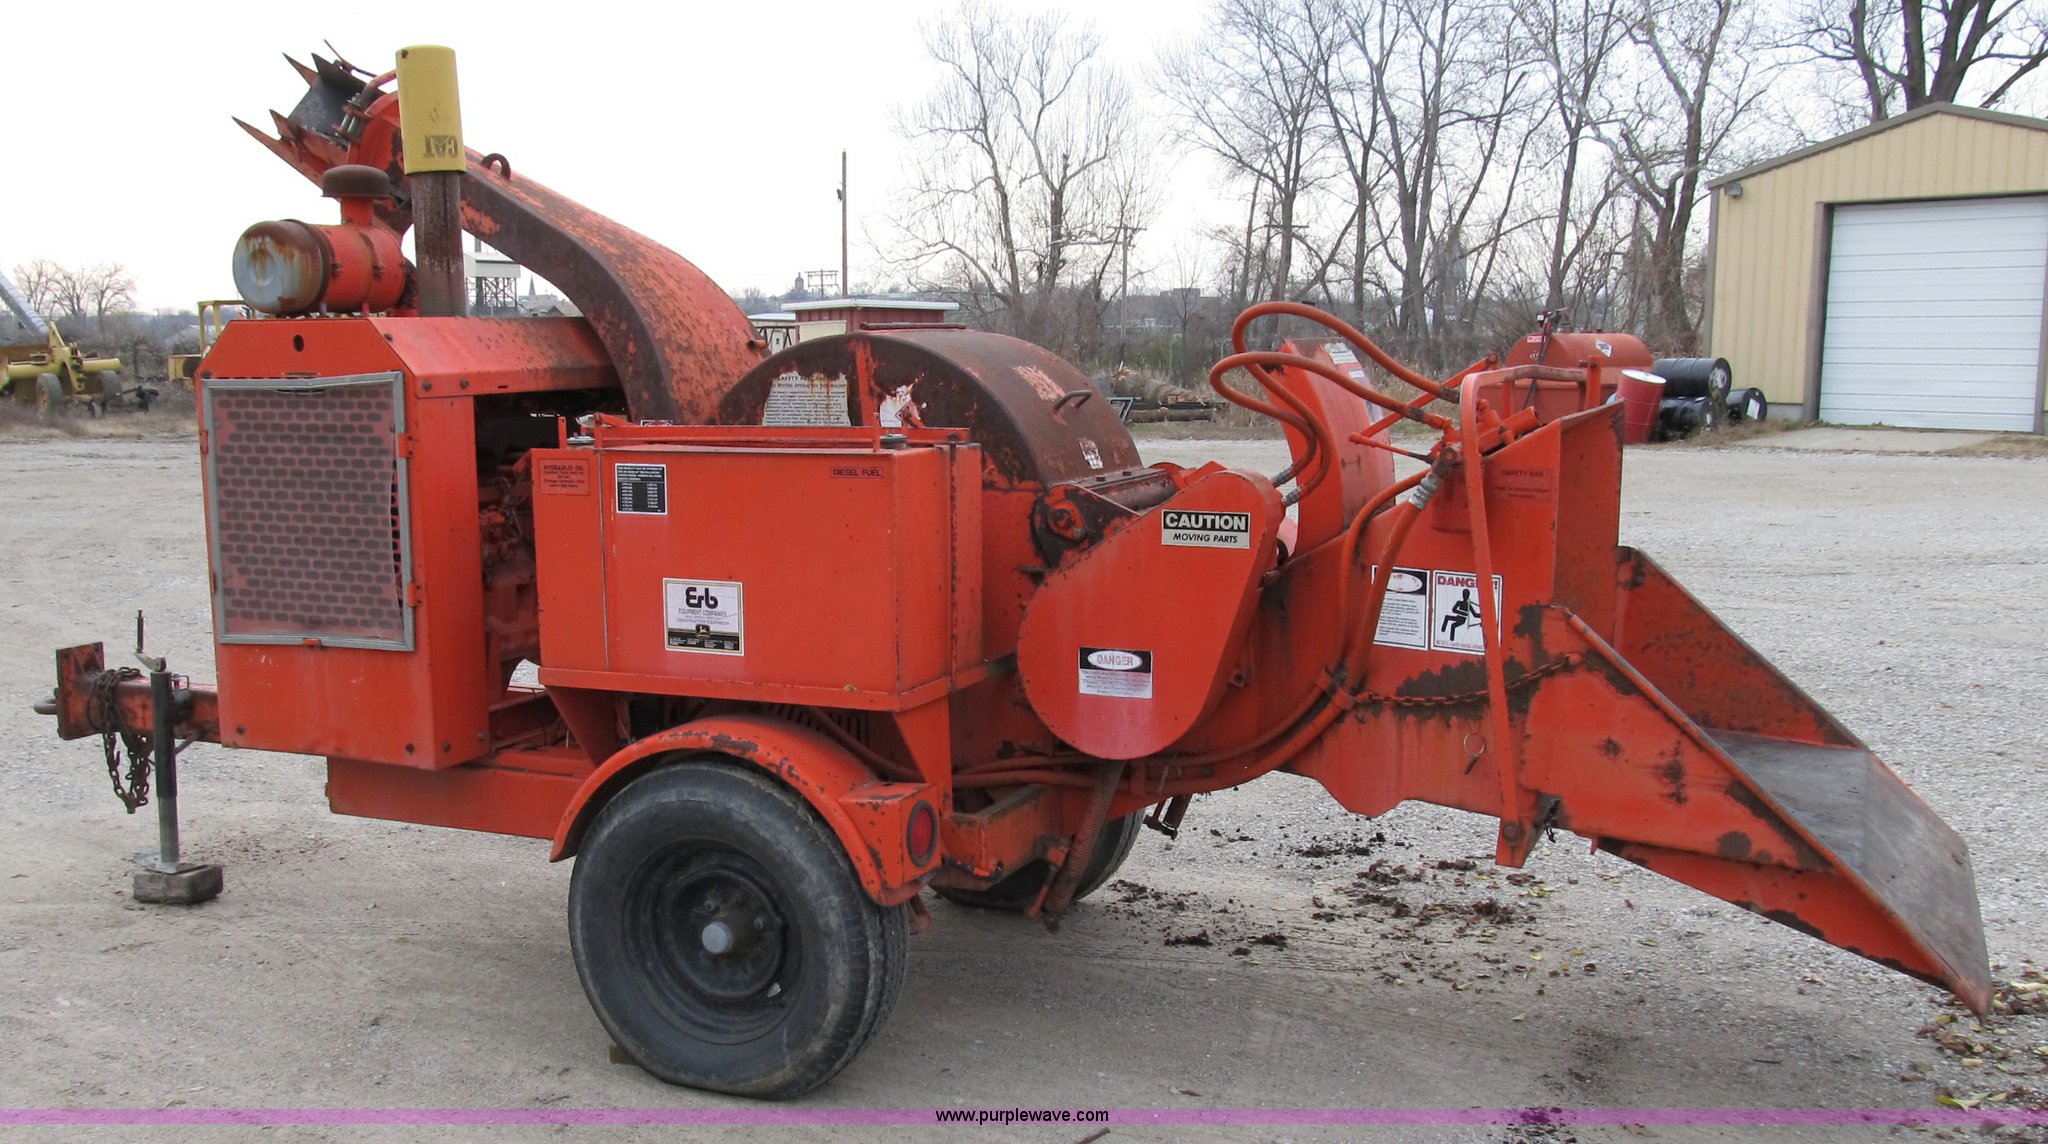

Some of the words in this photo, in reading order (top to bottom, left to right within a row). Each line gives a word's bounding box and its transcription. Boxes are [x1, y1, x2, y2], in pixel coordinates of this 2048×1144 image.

[423, 135, 458, 158] CAT
[832, 468, 859, 476] DIESEL
[862, 469, 881, 477] FUEL
[1165, 513, 1246, 530] CAUTION
[1173, 533, 1210, 542] MOVING
[1213, 535, 1238, 543] PARTS
[685, 586, 719, 609] Erb
[678, 608, 702, 616] EQUIPMENT
[1097, 654, 1133, 666] DANGER
